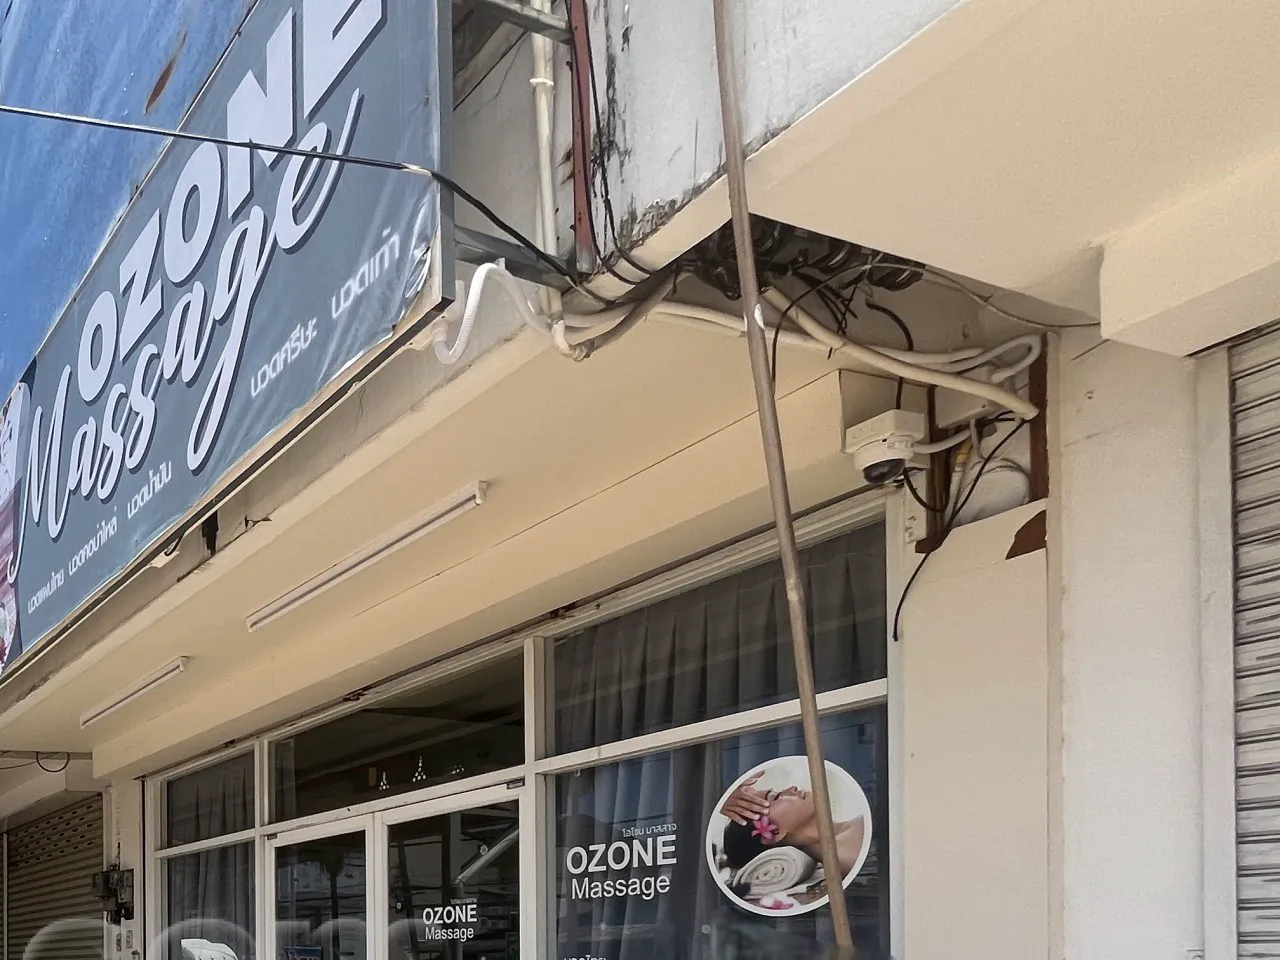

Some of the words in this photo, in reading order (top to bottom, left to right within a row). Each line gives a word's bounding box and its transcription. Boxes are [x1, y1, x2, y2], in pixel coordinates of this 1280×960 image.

[8, 88, 362, 584] Massage
[127, 460, 171, 519] นวดน้ำมัน
[566, 834, 677, 874] OZONE
[572, 875, 671, 900] Massage
[423, 904, 477, 925] OZONE
[425, 926, 474, 942] Massage
